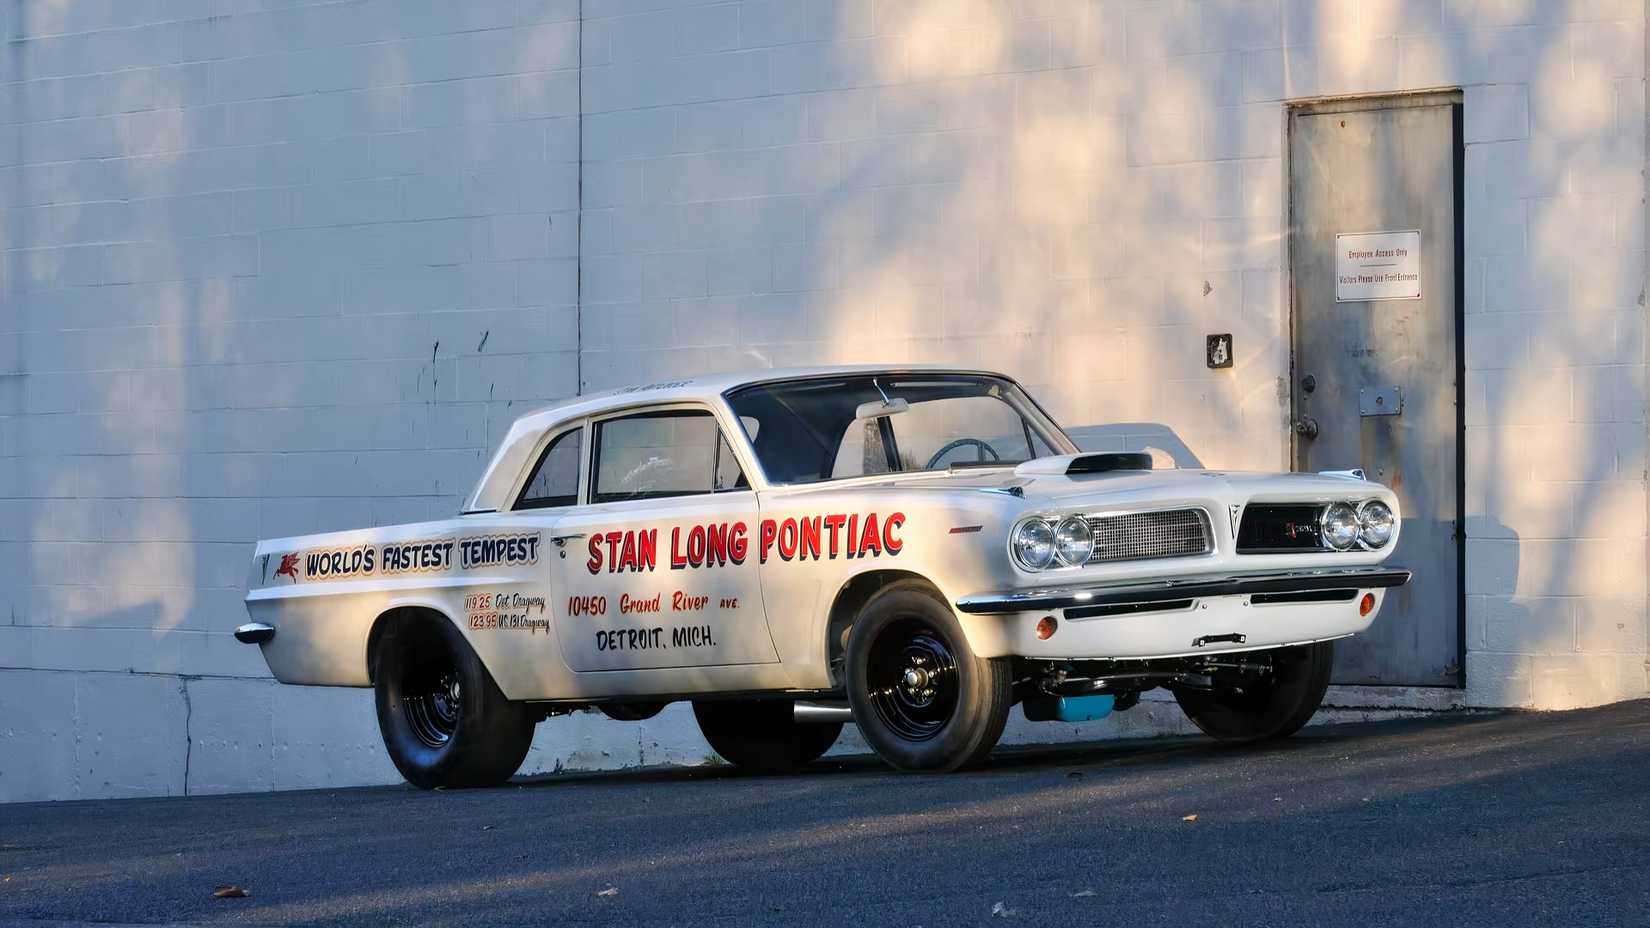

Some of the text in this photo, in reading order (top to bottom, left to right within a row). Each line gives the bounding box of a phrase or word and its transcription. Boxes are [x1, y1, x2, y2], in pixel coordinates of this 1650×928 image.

[1348, 250, 1373, 260] Employee
[1375, 249, 1394, 257] Access
[587, 512, 906, 575] STAN LONG PONTIAC
[305, 537, 539, 578] WORLD'S FASTEST TEMPEST
[568, 596, 607, 616] 10450
[620, 593, 660, 614] Grand
[672, 591, 708, 611] River
[672, 625, 717, 647] MICH.
